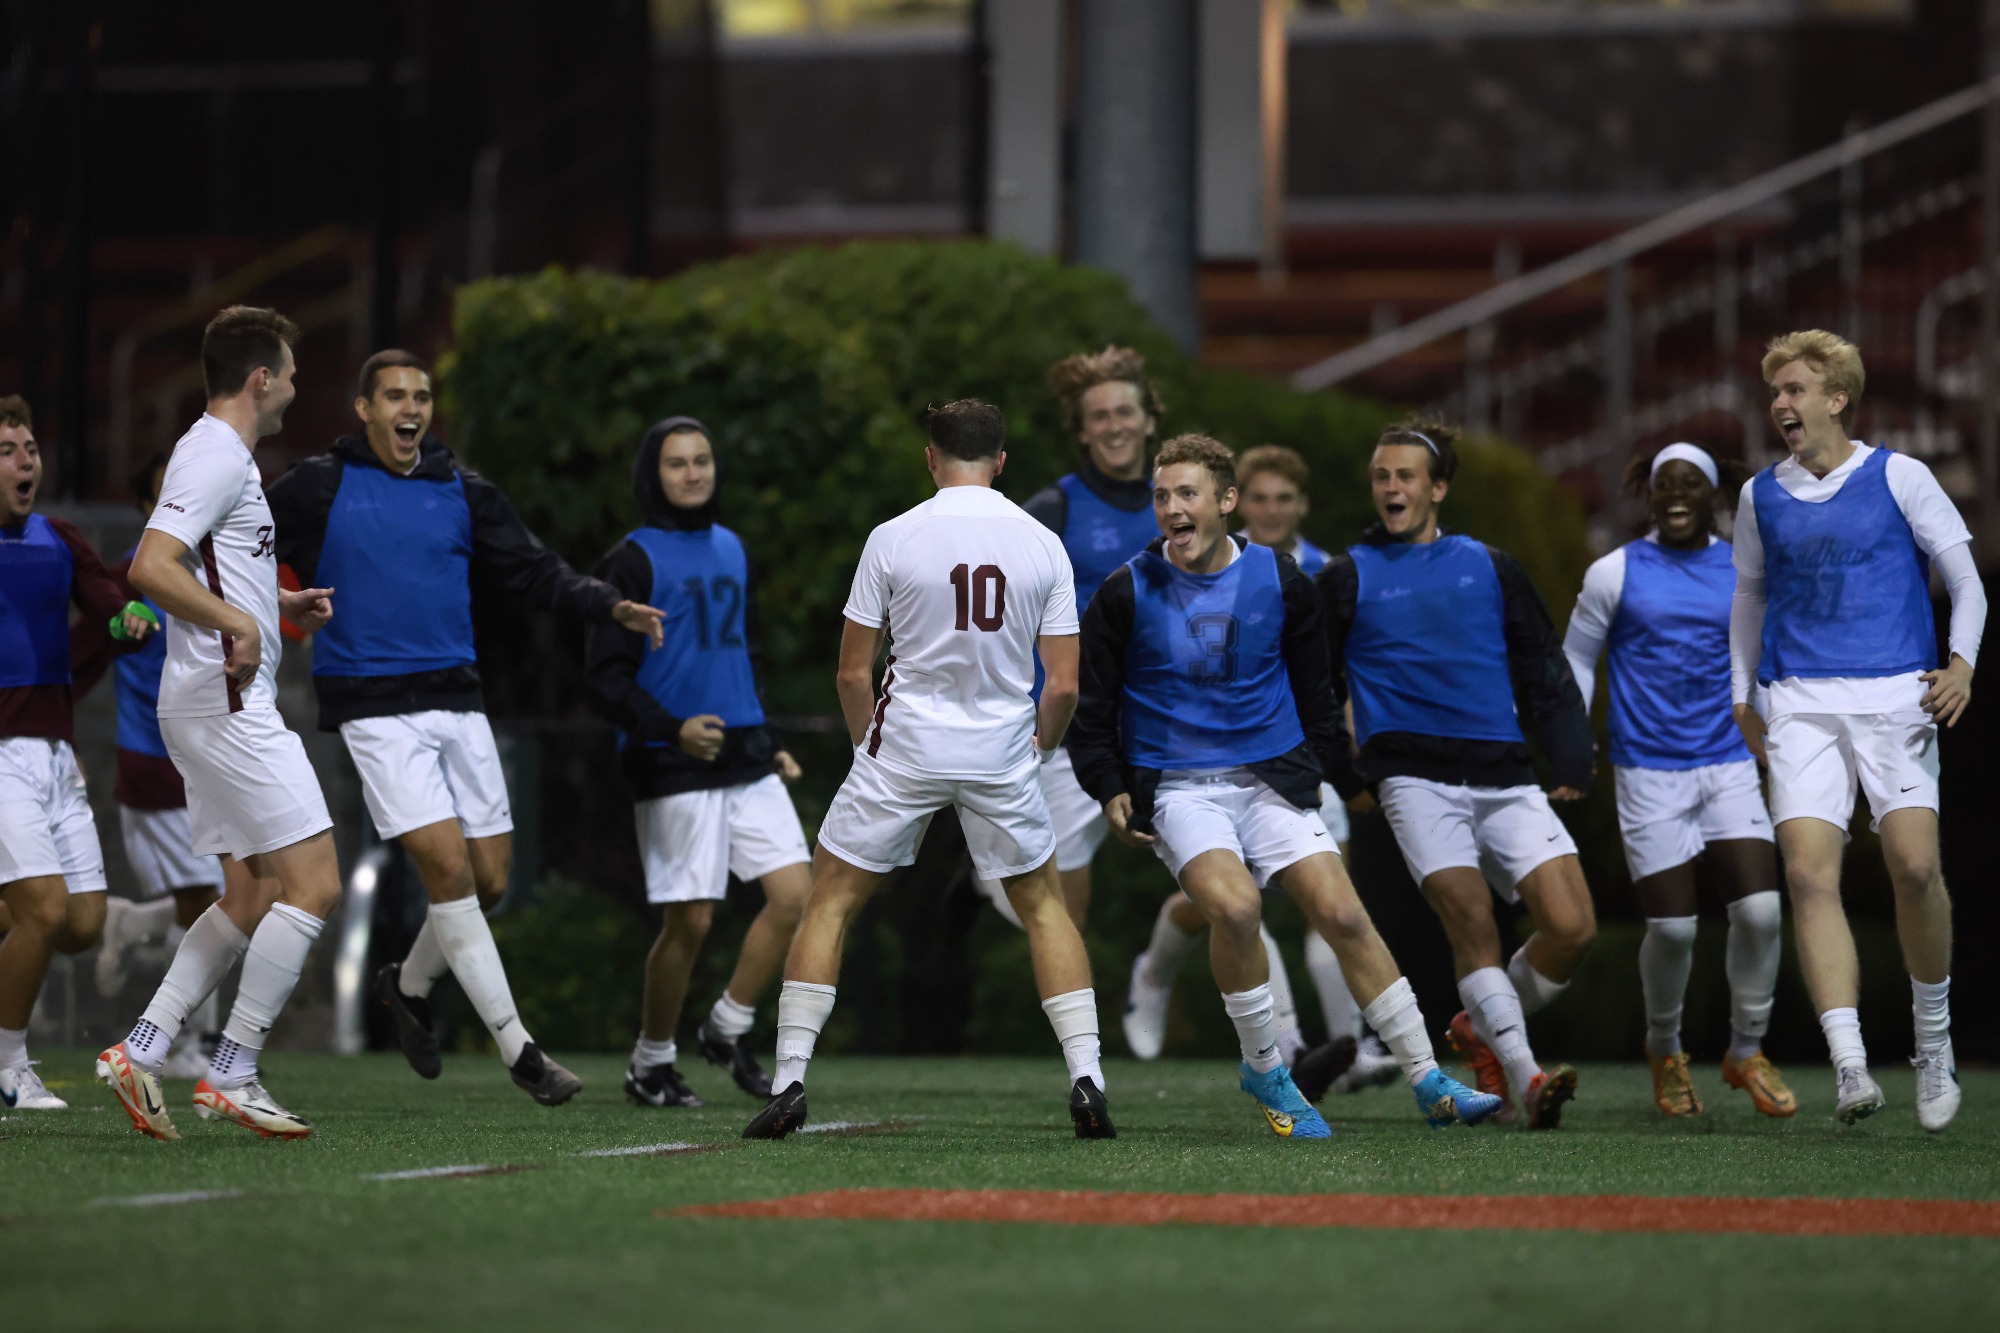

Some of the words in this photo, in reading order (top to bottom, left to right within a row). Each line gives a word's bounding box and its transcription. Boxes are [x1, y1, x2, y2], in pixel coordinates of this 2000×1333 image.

[682, 574, 742, 651] 12
[949, 563, 1006, 632] 10
[1185, 611, 1239, 687] 3
